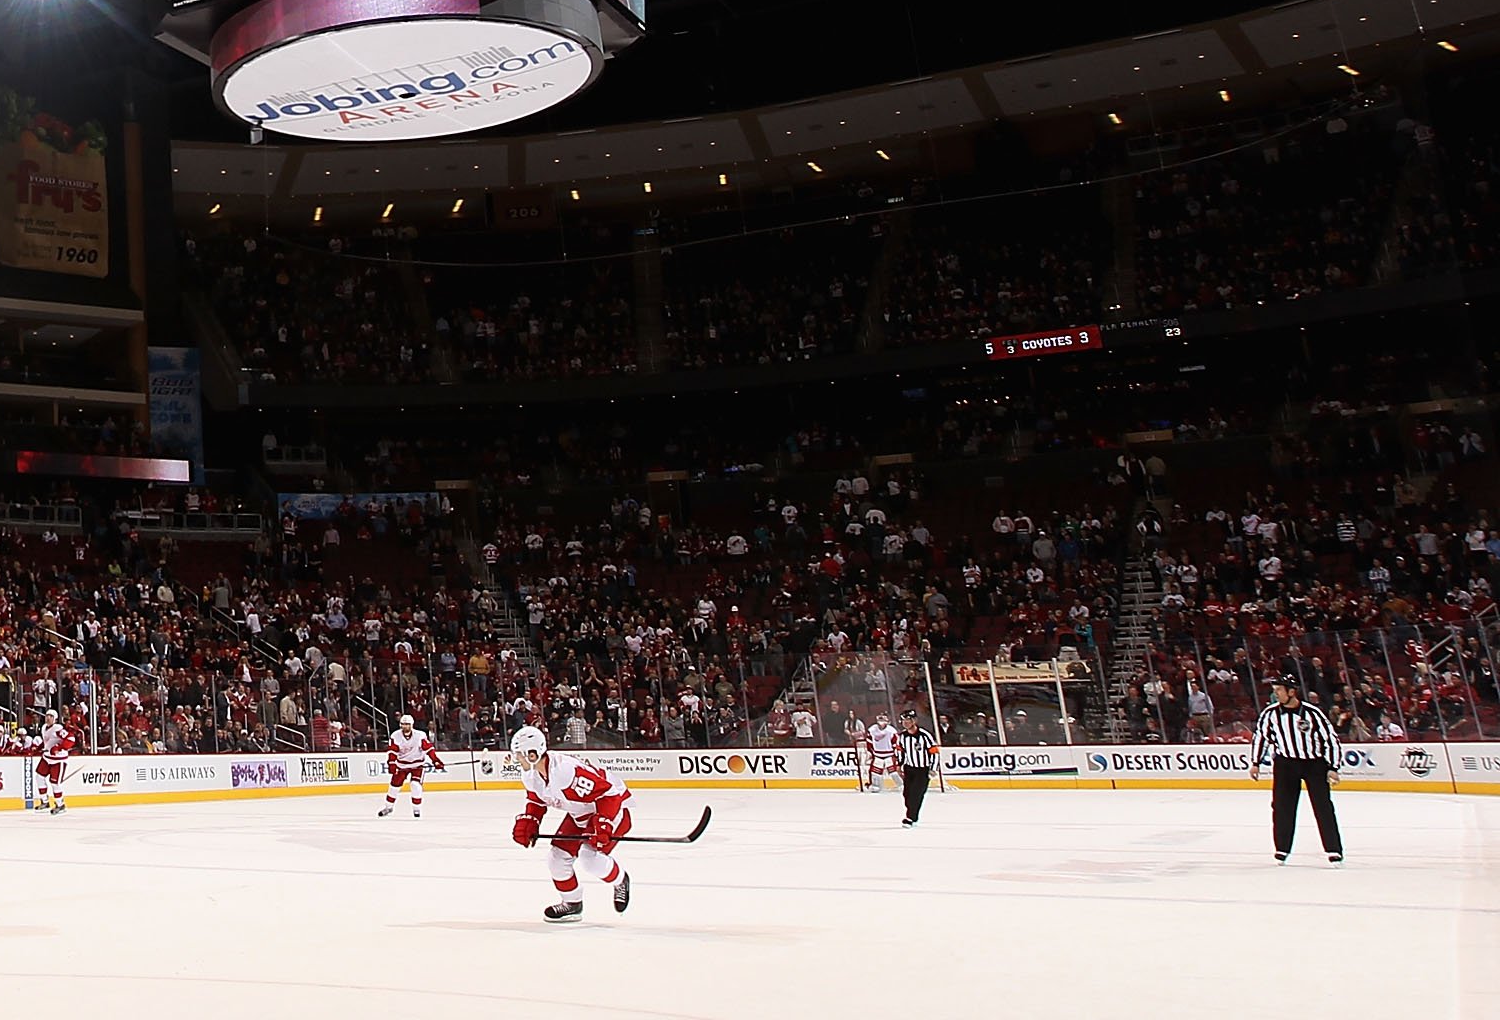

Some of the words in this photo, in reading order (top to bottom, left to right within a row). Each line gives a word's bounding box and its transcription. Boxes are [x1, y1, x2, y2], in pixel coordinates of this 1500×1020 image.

[244, 40, 576, 122] Jobing.com
[322, 112, 426, 134] GLENDALE
[452, 80, 555, 112] ARIZONA
[338, 81, 518, 126] ARENA
[6, 160, 102, 213] fry's
[57, 246, 98, 264] 1960
[1021, 335, 1073, 351] COYOTES
[1078, 331, 1089, 344] 3
[1165, 327, 1181, 337] 23
[1007, 345, 1015, 355] 3
[152, 387, 192, 396] IGHT
[636, 765, 655, 773] Away
[647, 757, 661, 765] Play
[679, 753, 788, 775] DISCOVER
[945, 751, 1051, 771] Jobing.com
[1112, 753, 1174, 771] DESERT
[1177, 751, 1250, 771] SCHOOLS
[1401, 754, 1438, 769] NHL
[82, 768, 120, 787] verizon
[168, 766, 216, 780] AIRWAYS
[574, 775, 595, 798] 48
